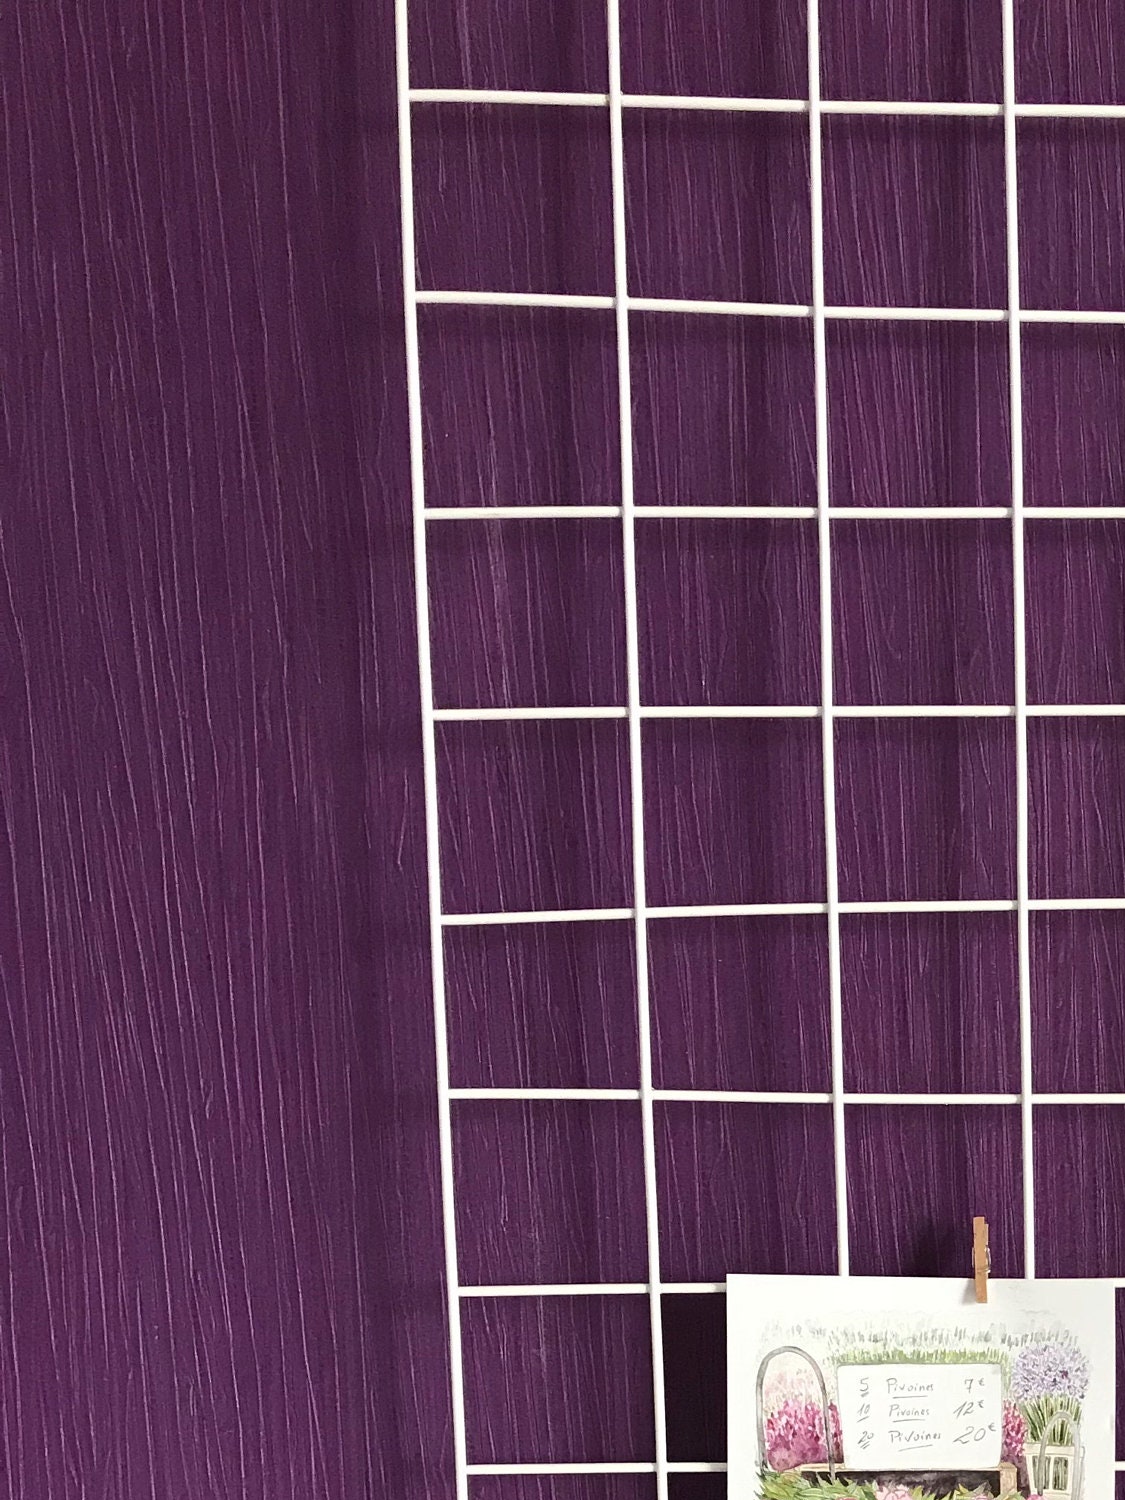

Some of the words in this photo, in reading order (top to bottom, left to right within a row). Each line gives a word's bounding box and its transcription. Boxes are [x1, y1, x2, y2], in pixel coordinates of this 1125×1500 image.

[859, 1377, 870, 1392] 5
[886, 1377, 934, 1394] Pivoines
[856, 1403, 871, 1415] 10
[888, 1404, 930, 1417] Pivoines
[857, 1430, 874, 1445] 20
[888, 1430, 942, 1444] Pivoines
